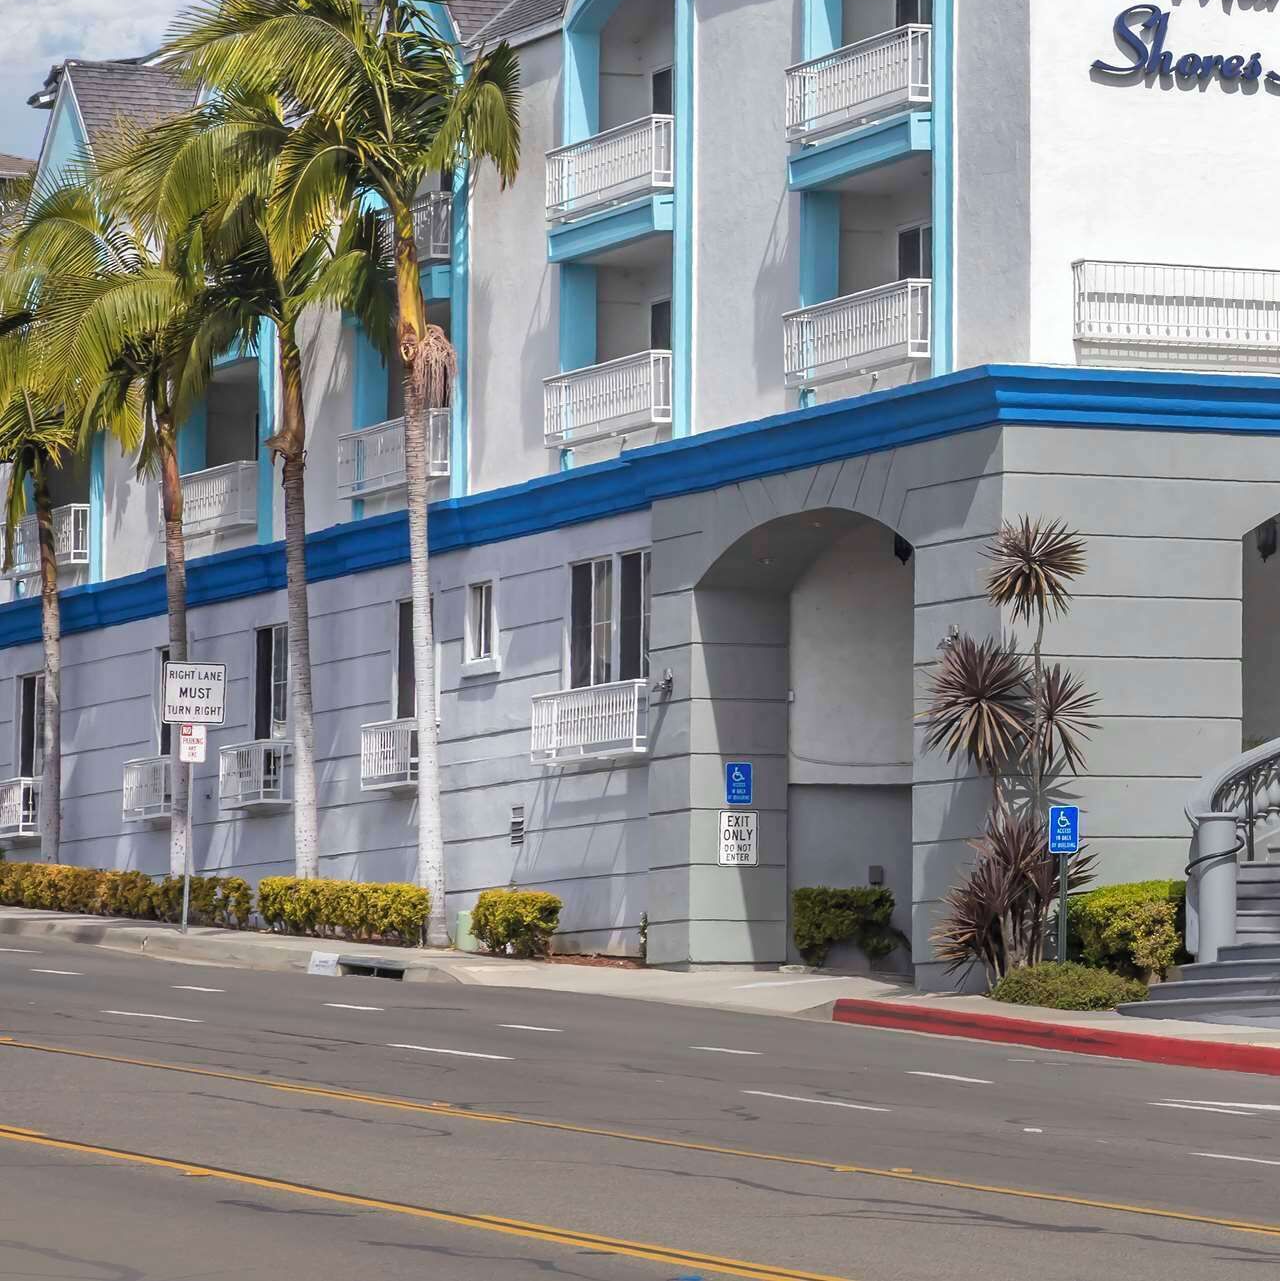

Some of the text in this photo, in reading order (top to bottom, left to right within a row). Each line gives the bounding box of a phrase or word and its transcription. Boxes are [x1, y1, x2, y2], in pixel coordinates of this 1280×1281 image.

[1089, 4, 1262, 81] Shores
[169, 670, 223, 681] RIGHT LANE
[179, 687, 212, 699] MUST
[167, 704, 222, 716] TURN RIGHT
[727, 815, 750, 827] EXIT
[723, 829, 753, 841] ONLY
[724, 843, 752, 852] DO NOT
[725, 853, 750, 862] ENTER
